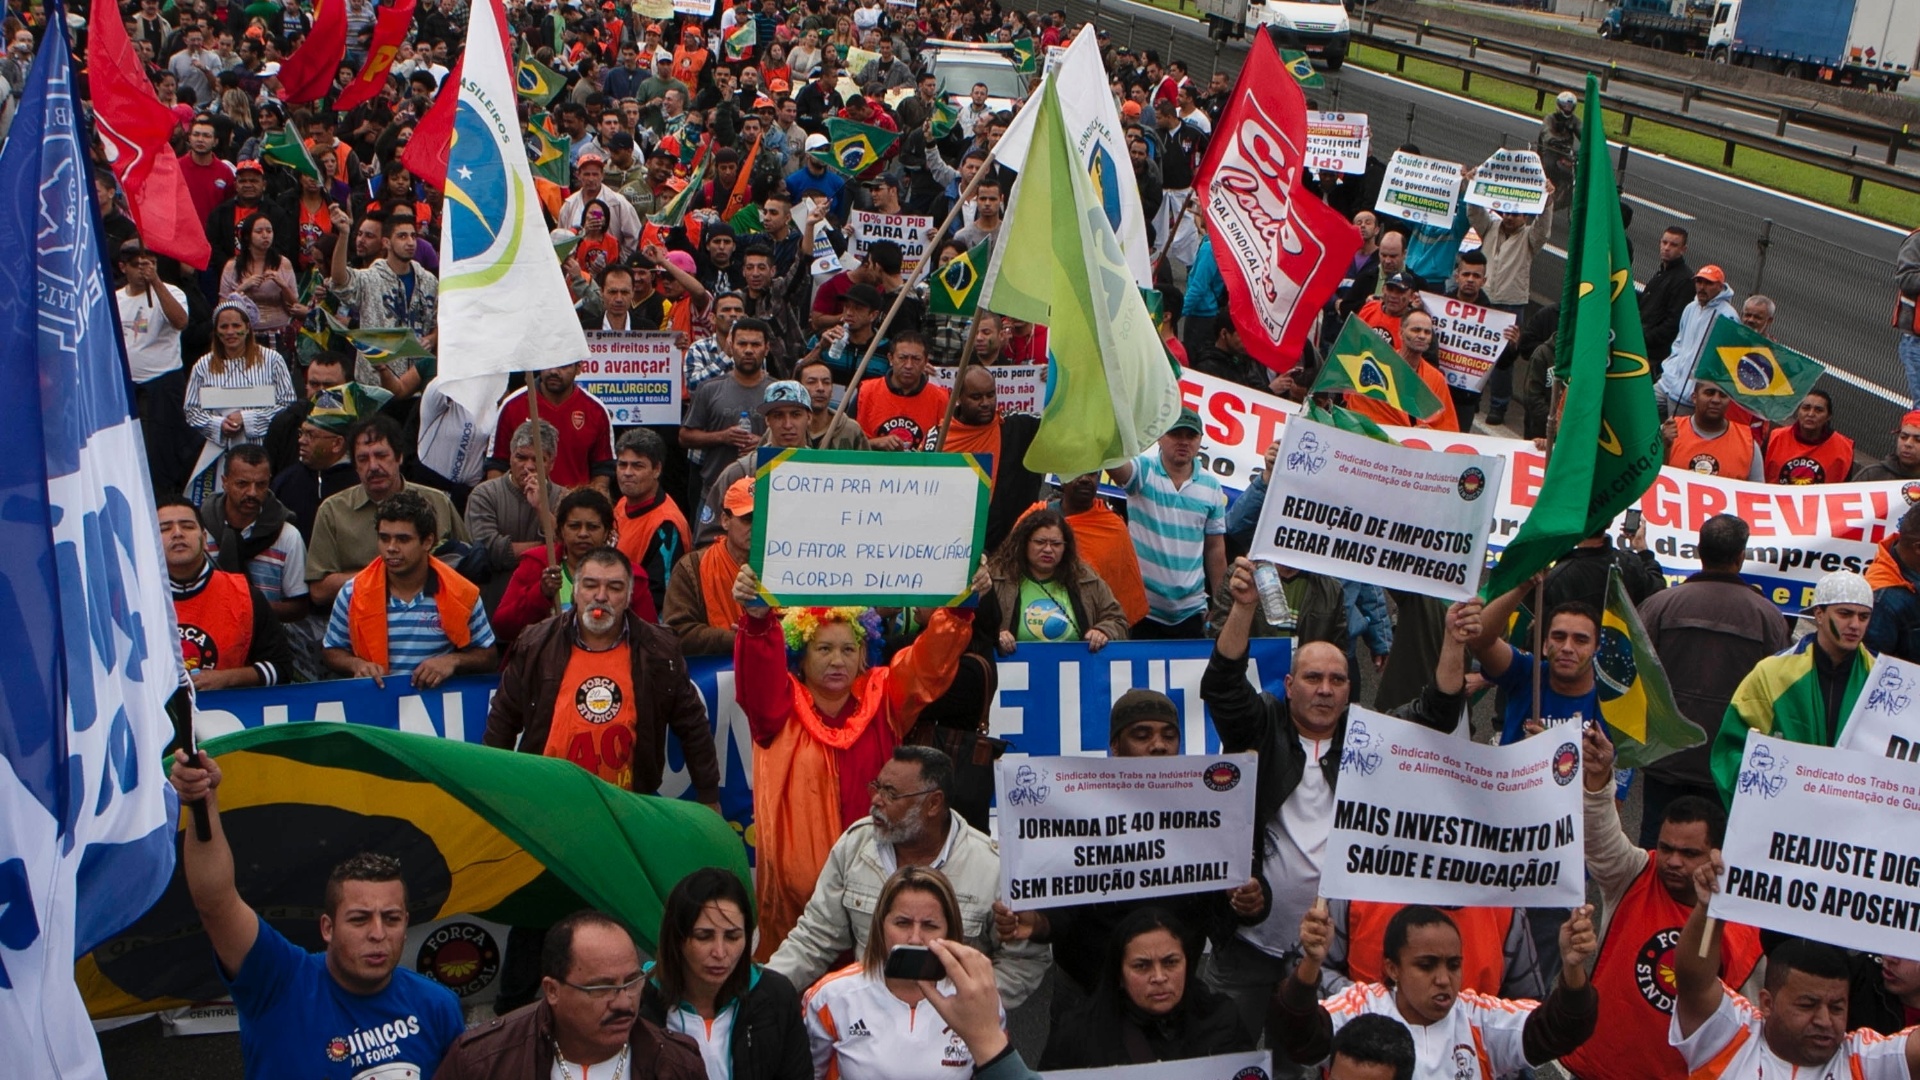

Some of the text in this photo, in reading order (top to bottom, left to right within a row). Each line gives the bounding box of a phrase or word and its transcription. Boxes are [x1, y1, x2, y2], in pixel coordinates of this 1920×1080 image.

[460, 77, 510, 144] ASILEIROS
[1306, 146, 1337, 157] tarifa
[1394, 166, 1404, 175] do
[1404, 169, 1424, 180] povo
[1430, 161, 1457, 175] direito
[1490, 162, 1511, 172] povo
[1390, 177, 1451, 198] dos governantes
[1494, 173, 1543, 187] governantes
[859, 212, 926, 228] 10% DO PIB
[863, 224, 918, 241] PARA A
[856, 239, 923, 257] EDÇÃO
[1227, 222, 1261, 276] SINDICAL
[1445, 300, 1488, 324] CPI
[596, 330, 621, 339] gente
[1431, 315, 1501, 342] as tarifas
[611, 341, 671, 354] direitos não
[1434, 327, 1498, 358] úblicas!
[604, 357, 671, 378] avançar!
[1438, 350, 1494, 371] ETALÚRGICOS
[940, 368, 951, 380] Se
[1011, 368, 1036, 380] parar
[587, 380, 669, 394] METALÚRGICOS
[1017, 382, 1035, 394] não
[460, 422, 472, 451] AXIOS
[883, 417, 919, 436] FORÇA
[1334, 450, 1460, 484] Sindicato dos Trabs na Indústrias
[1463, 467, 1484, 479] FORÇA
[1787, 458, 1820, 473] FORÇA
[771, 474, 940, 496] CORTA PRA MIM!!!
[1338, 463, 1452, 495] de Alimentação de Guarulhos
[841, 509, 884, 526] FIM
[1640, 474, 1889, 544] GREVE!
[1282, 494, 1363, 532] REDUÇÃO
[1364, 515, 1388, 539] DE
[1388, 521, 1474, 555] IMPOSTOS
[767, 537, 973, 561] DO FATOR PREVIDENCIÁRIO
[1273, 525, 1330, 557] GERAR
[1331, 537, 1377, 566] MAIS
[1377, 548, 1468, 585] EMPREGOS
[1745, 546, 1874, 576] mpres
[781, 570, 924, 590] ACORDA DILMA
[177, 627, 207, 647] RÇA
[580, 677, 616, 693] FORÇA
[577, 702, 621, 724] SINDICAL
[1390, 743, 1550, 780] Sindicato dos Trabs na Indústrias
[1554, 743, 1577, 760] FORÇA
[1055, 768, 1203, 782] Sindicato dos Trabs na Indústrias
[1208, 761, 1237, 774] FORÇA
[1398, 760, 1544, 793] de Alimentação de Guarulhos
[1553, 763, 1580, 786] SINDICAL
[1064, 779, 1194, 793] de Alimentação de Guarulhos
[1205, 777, 1241, 792] SINDICAL
[1795, 765, 1915, 795] Sindicato dos Trabs na
[1803, 781, 1900, 807] de Alimentação de
[1018, 810, 1222, 840] JORNADA DE 40 HORAS
[1333, 799, 1575, 853] MAIS INVESTIMENTO NA
[1074, 838, 1166, 868] SEMANAIS
[1769, 831, 1920, 888] REAJUSTE DIG
[1346, 843, 1561, 892] SAÚDE E EDUCAÇÃO!
[1010, 861, 1229, 900] SEM REDUÇÃO SALARIAL!
[1725, 865, 1920, 933] PARA OS APOSENT
[426, 925, 486, 951] FORÇA
[1636, 963, 1679, 1013] SINDI
[190, 1007, 237, 1020] CENTRAL
[365, 1043, 401, 1065] FORÇA
